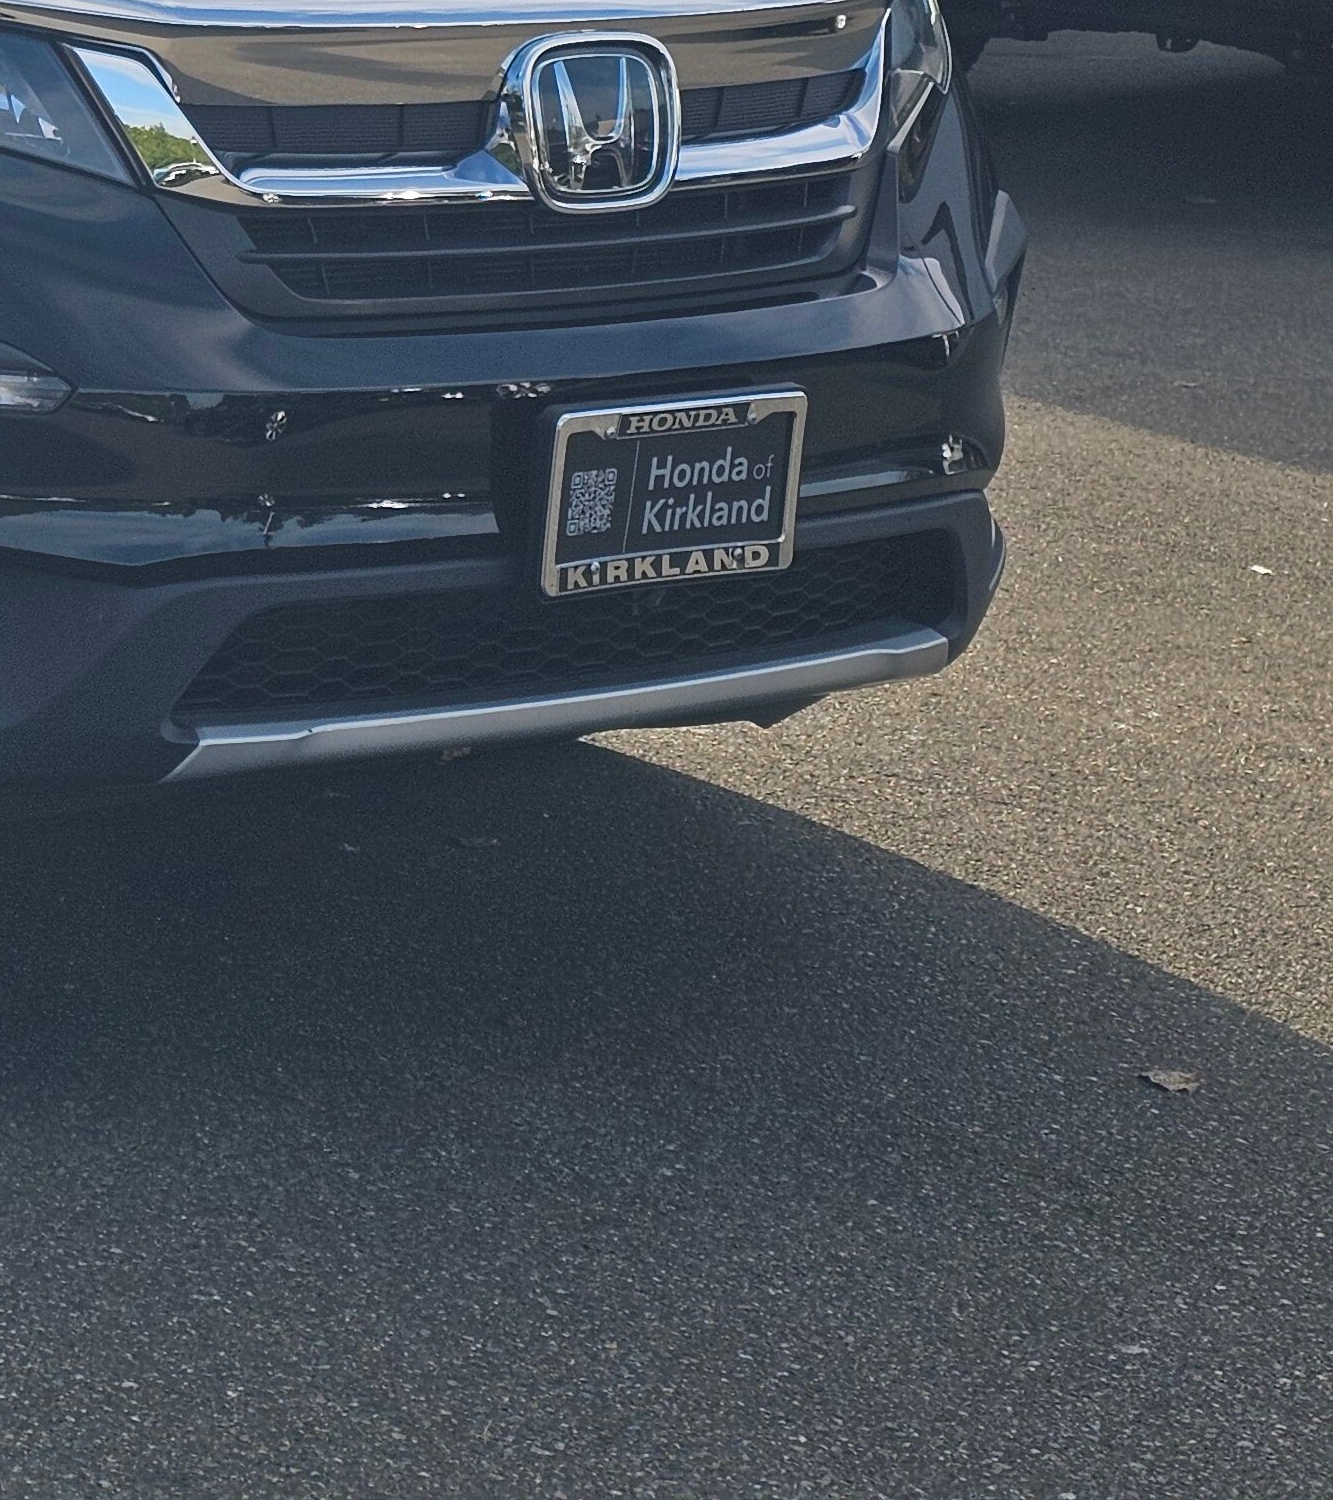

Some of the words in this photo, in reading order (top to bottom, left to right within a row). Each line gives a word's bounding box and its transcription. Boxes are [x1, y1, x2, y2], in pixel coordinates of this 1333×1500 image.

[625, 407, 739, 434] HONDA
[647, 446, 749, 491] Honda
[752, 454, 775, 481] of
[641, 485, 771, 535] Kirkland
[566, 545, 770, 590] KIRKLAND
